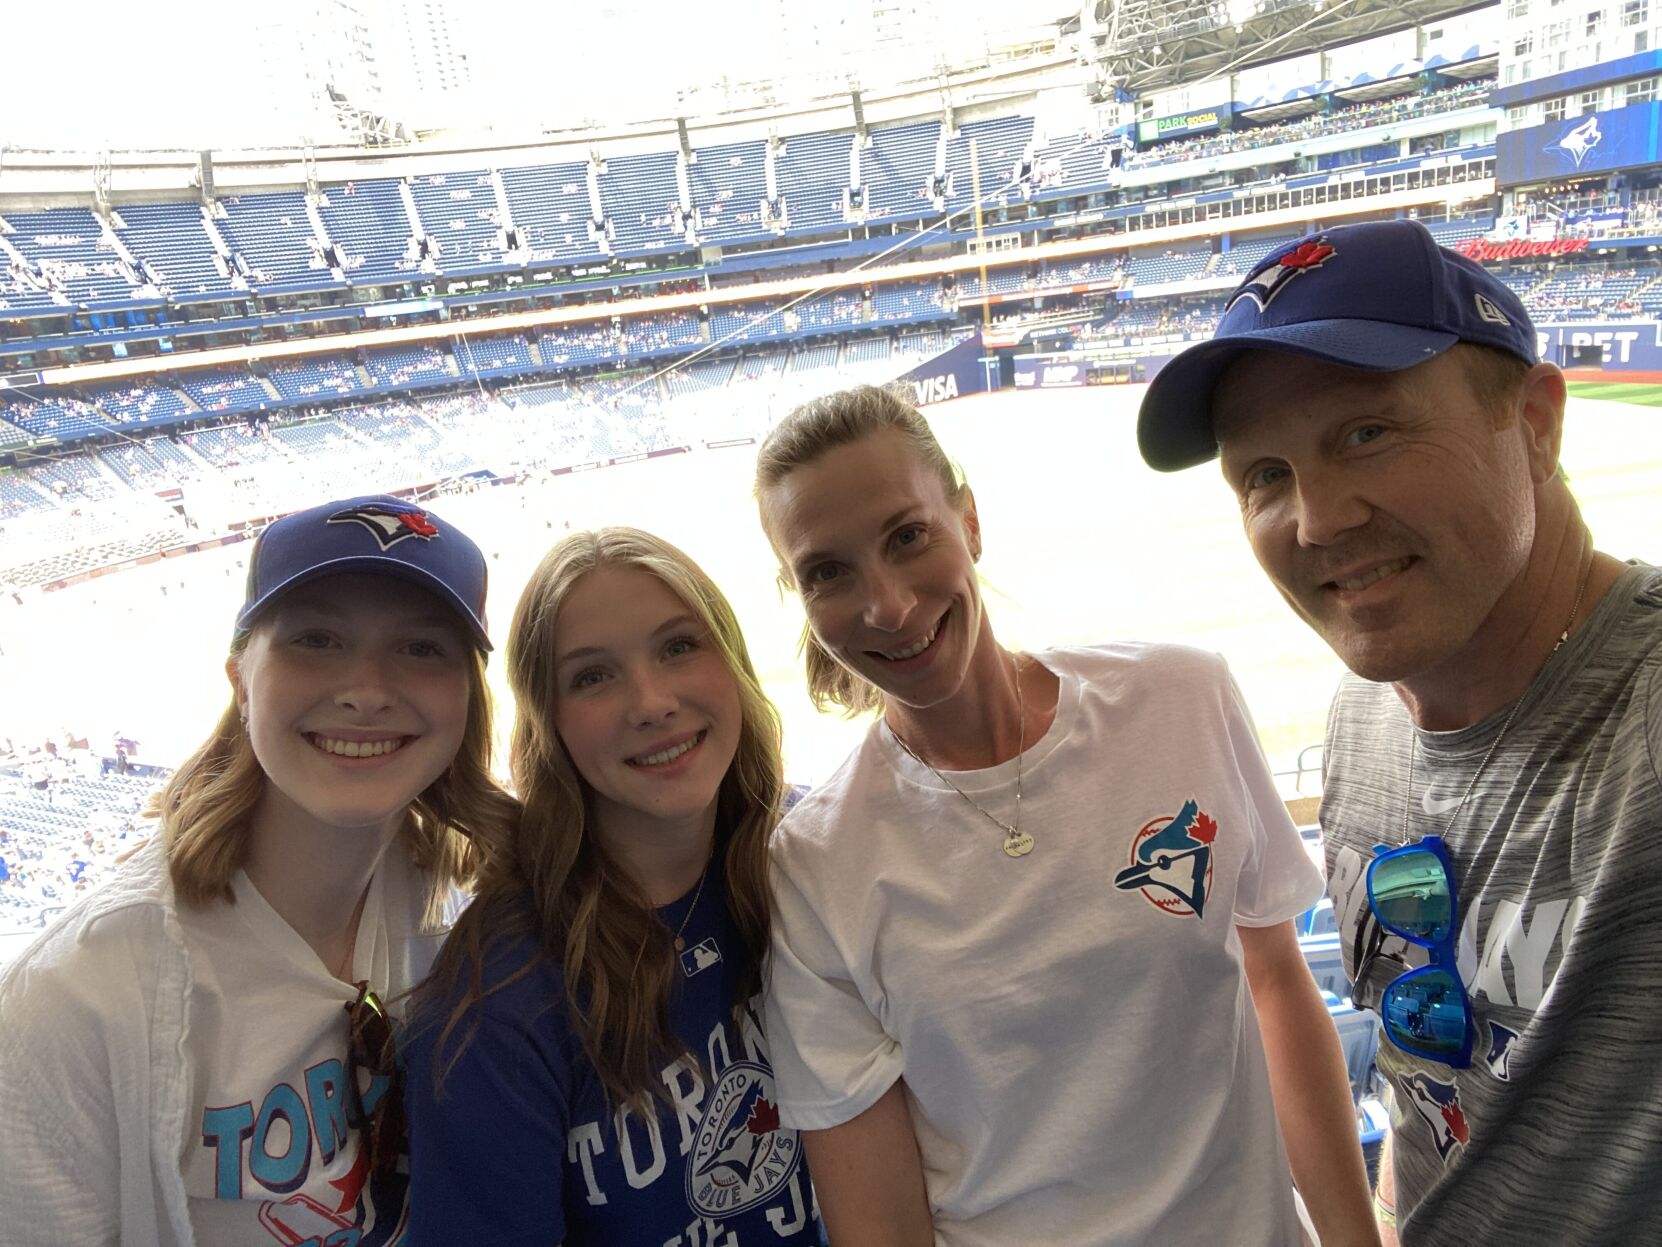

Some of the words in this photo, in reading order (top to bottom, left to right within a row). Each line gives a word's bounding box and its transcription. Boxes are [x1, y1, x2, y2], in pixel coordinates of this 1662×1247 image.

[1159, 115, 1187, 130] PARK
[1187, 112, 1218, 127] SOCIAL
[1456, 236, 1590, 263] Budweiser
[1571, 331, 1639, 363] PET
[913, 374, 959, 406] VISA
[697, 1073, 747, 1160] TORONTO
[697, 1182, 742, 1208] BLUE
[754, 1136, 794, 1194] JAYS
